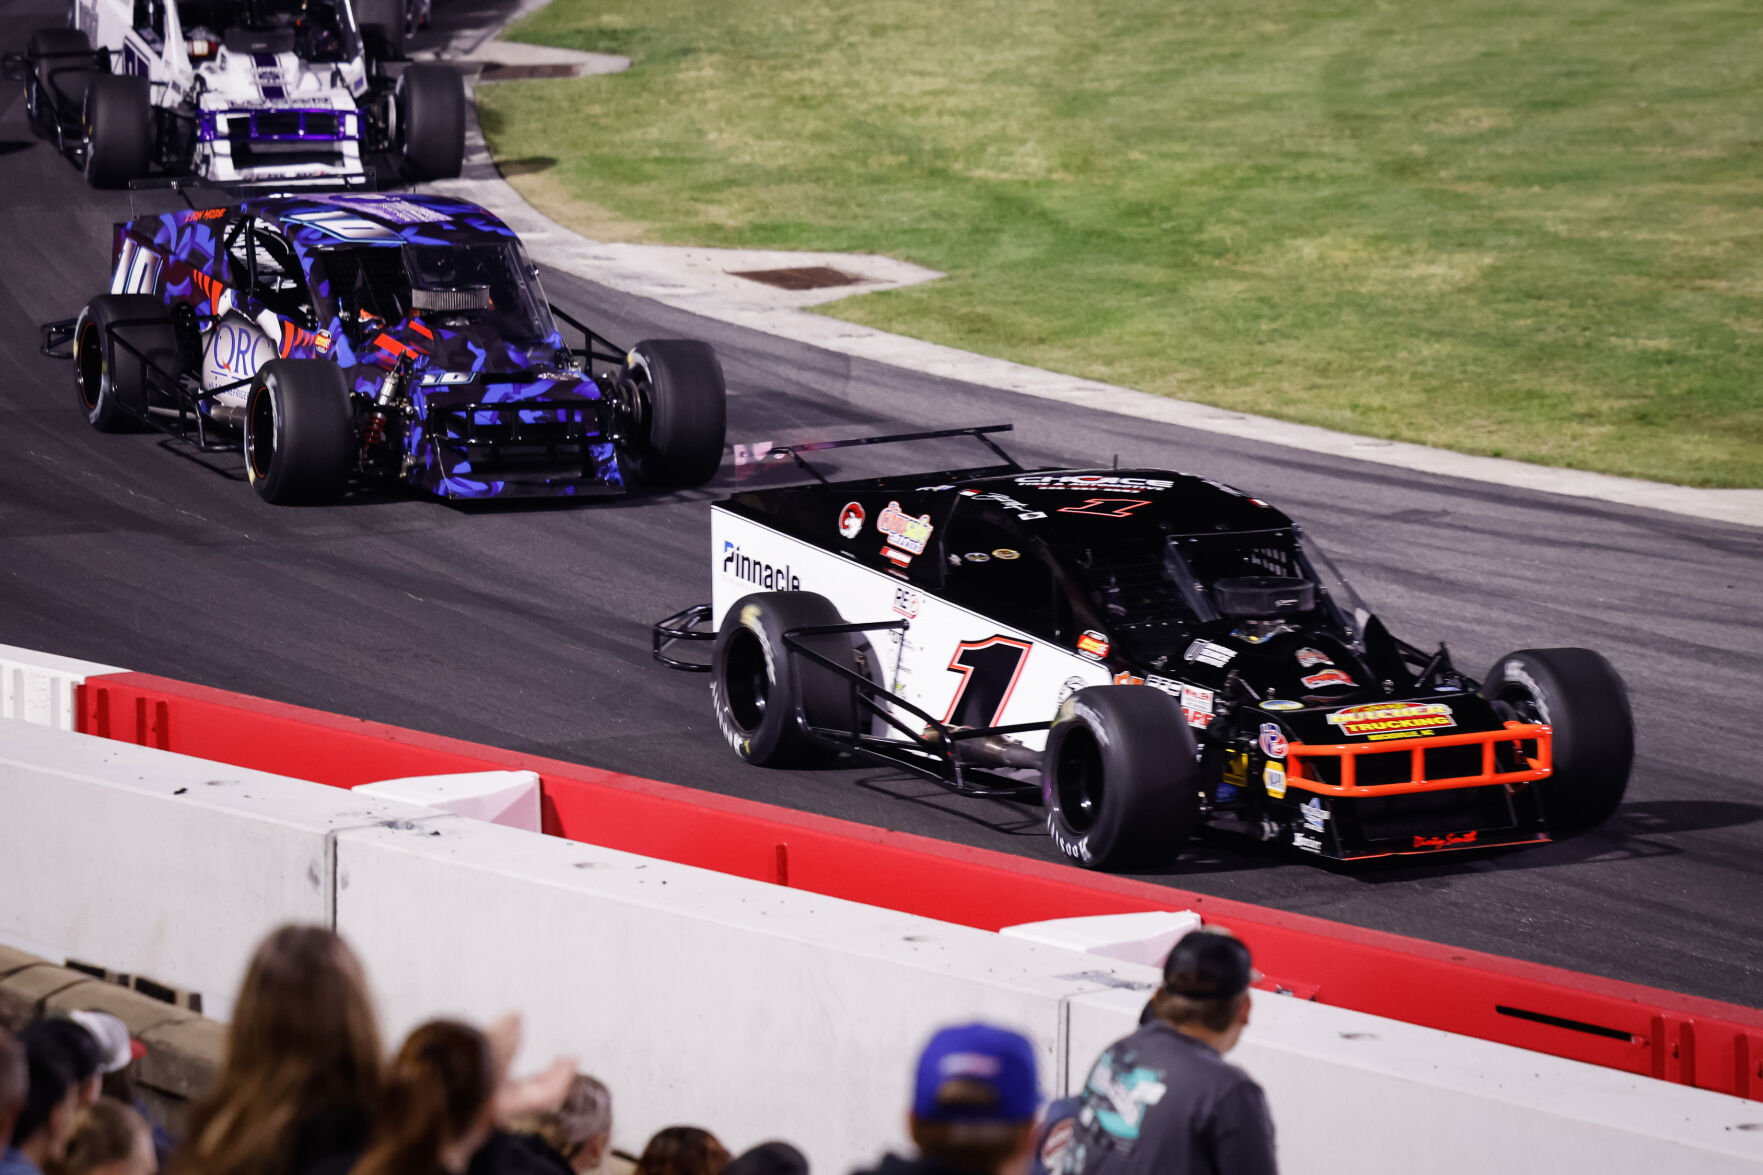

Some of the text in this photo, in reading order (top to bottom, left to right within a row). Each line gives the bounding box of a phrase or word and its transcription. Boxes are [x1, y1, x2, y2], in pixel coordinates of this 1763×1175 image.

[1014, 475, 1175, 488] CHOICE
[723, 541, 801, 592] Pinnacle
[941, 633, 1034, 728] 1
[1346, 717, 1451, 732] TRUCKING
